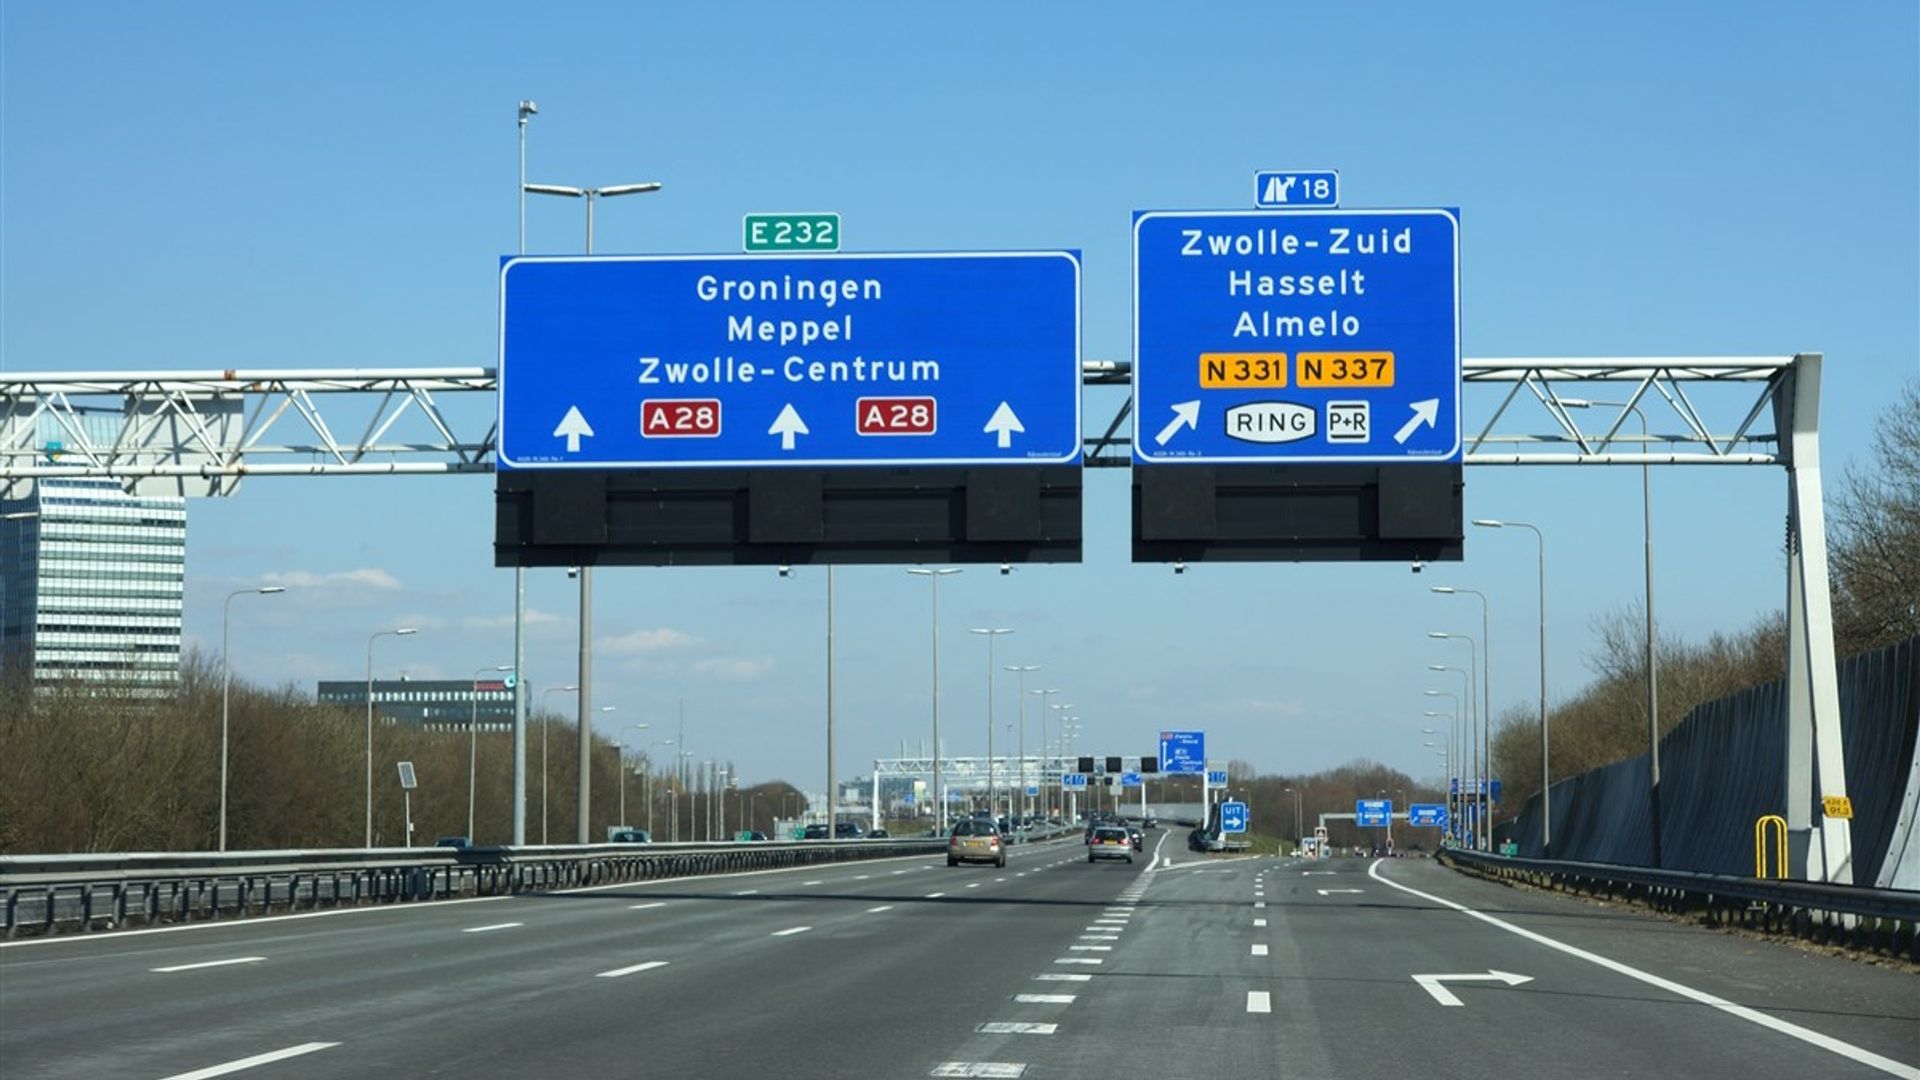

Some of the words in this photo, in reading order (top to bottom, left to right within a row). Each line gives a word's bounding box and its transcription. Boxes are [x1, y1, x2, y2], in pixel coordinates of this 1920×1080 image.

[1302, 180, 1330, 198] 18
[1181, 227, 1412, 256] Zwolle-Zuid
[696, 275, 881, 308] Groningen
[1229, 269, 1365, 297] Hasselt
[727, 315, 851, 346] Meppel
[1233, 310, 1360, 337] Almelo
[638, 355, 940, 384] Zwolle-Centrum
[1237, 412, 1307, 432] RING
[1329, 412, 1367, 432] P+R
[1225, 806, 1241, 815] UIT
